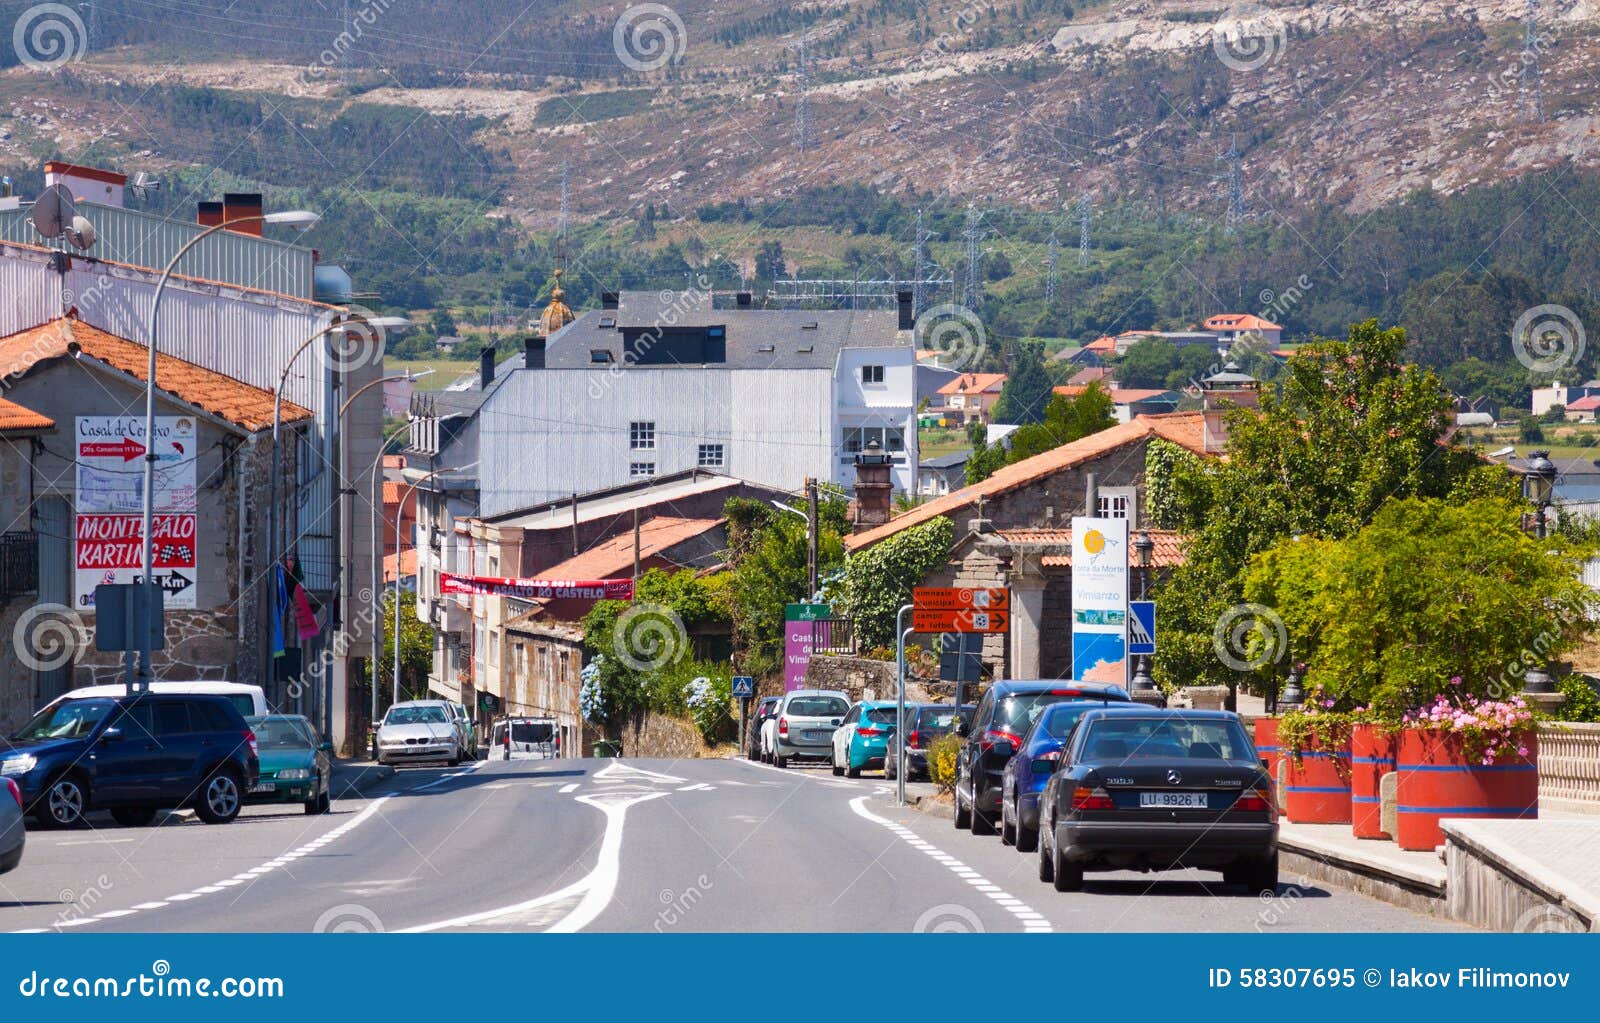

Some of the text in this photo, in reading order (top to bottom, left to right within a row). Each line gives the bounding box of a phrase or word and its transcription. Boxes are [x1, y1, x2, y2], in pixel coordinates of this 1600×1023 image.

[80, 419, 112, 437] Casal
[161, 576, 185, 588] Km
[493, 585, 535, 597] ASALTO
[555, 587, 604, 599] CASTELO
[1076, 589, 1120, 601] Vimianzo
